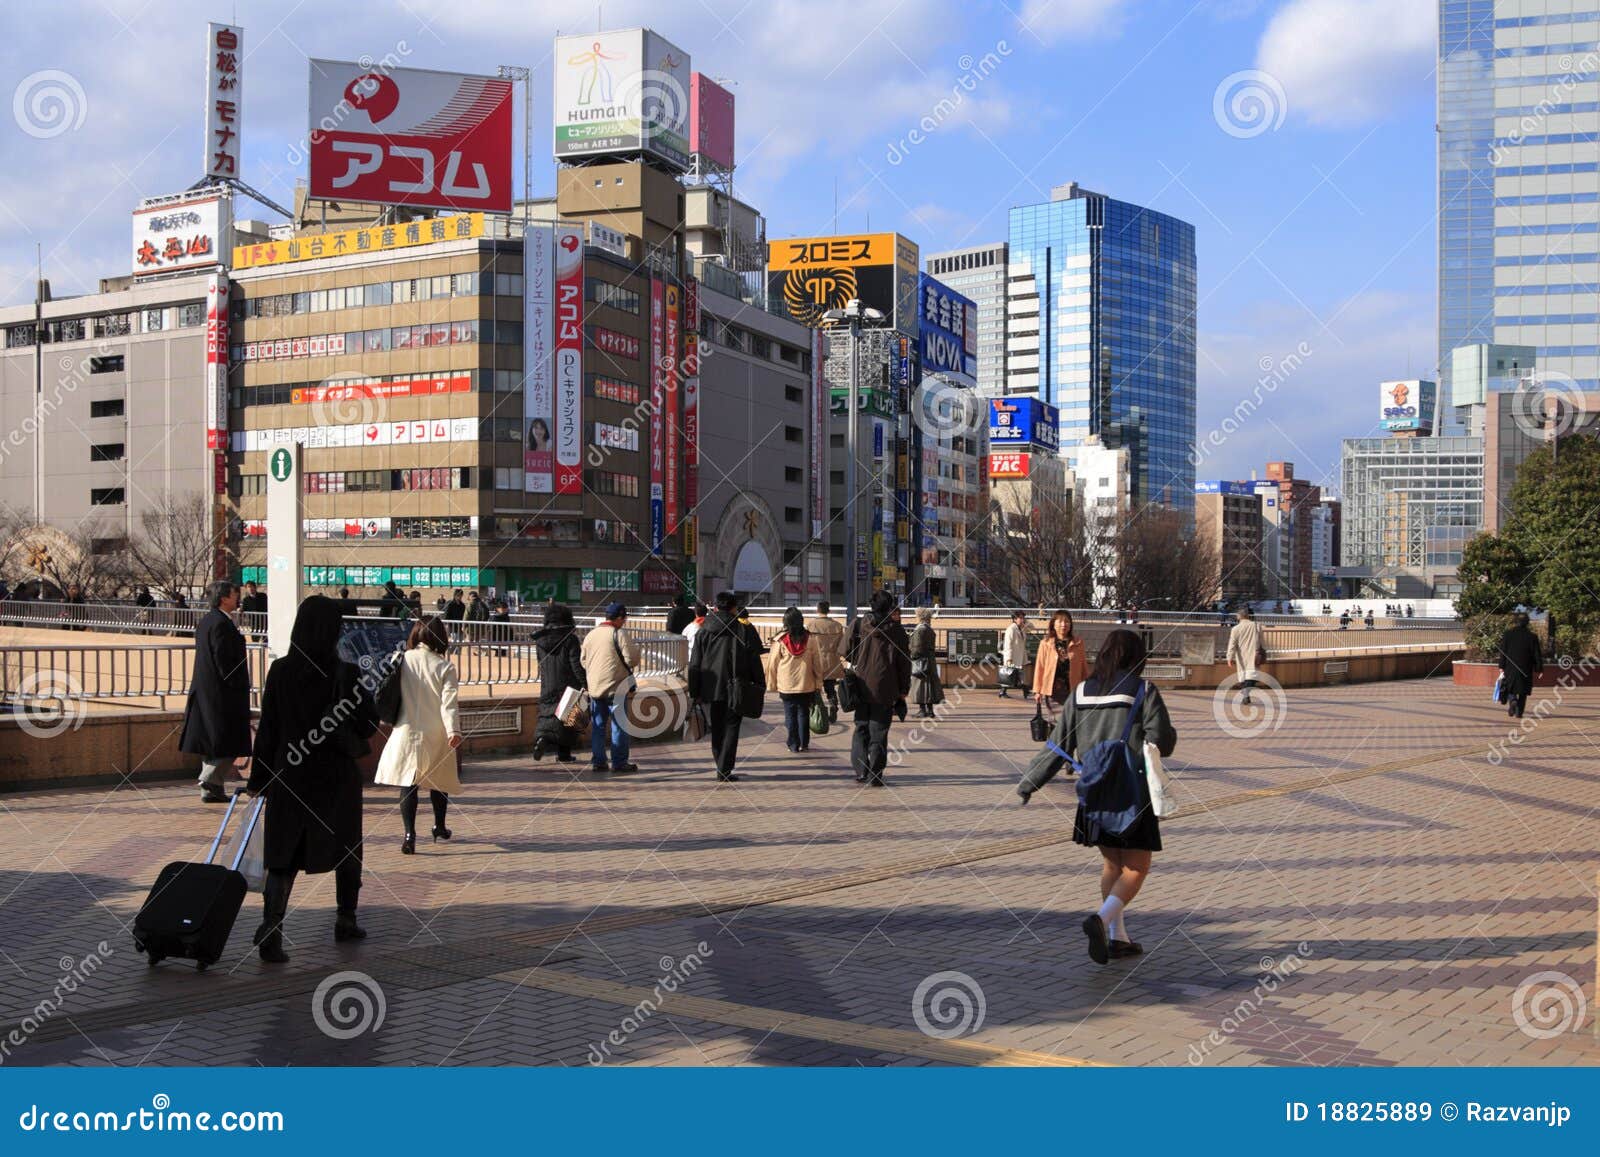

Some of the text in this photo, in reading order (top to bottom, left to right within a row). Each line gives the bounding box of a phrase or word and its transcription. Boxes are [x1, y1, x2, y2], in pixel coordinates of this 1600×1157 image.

[214, 28, 239, 174] 白松がモナカ
[568, 105, 627, 121] Human
[332, 140, 491, 199] アコム
[138, 235, 210, 265] 太平山
[241, 216, 473, 265] 1F 仙台不動産情報館
[790, 240, 872, 264] プロミス
[560, 285, 579, 340] アコム
[926, 285, 963, 337] 英会話
[926, 331, 961, 373] NOVA
[395, 425, 446, 440] アコム
[560, 475, 577, 485] 6F
[992, 461, 1020, 472] TAC
[309, 569, 336, 582] レイク
